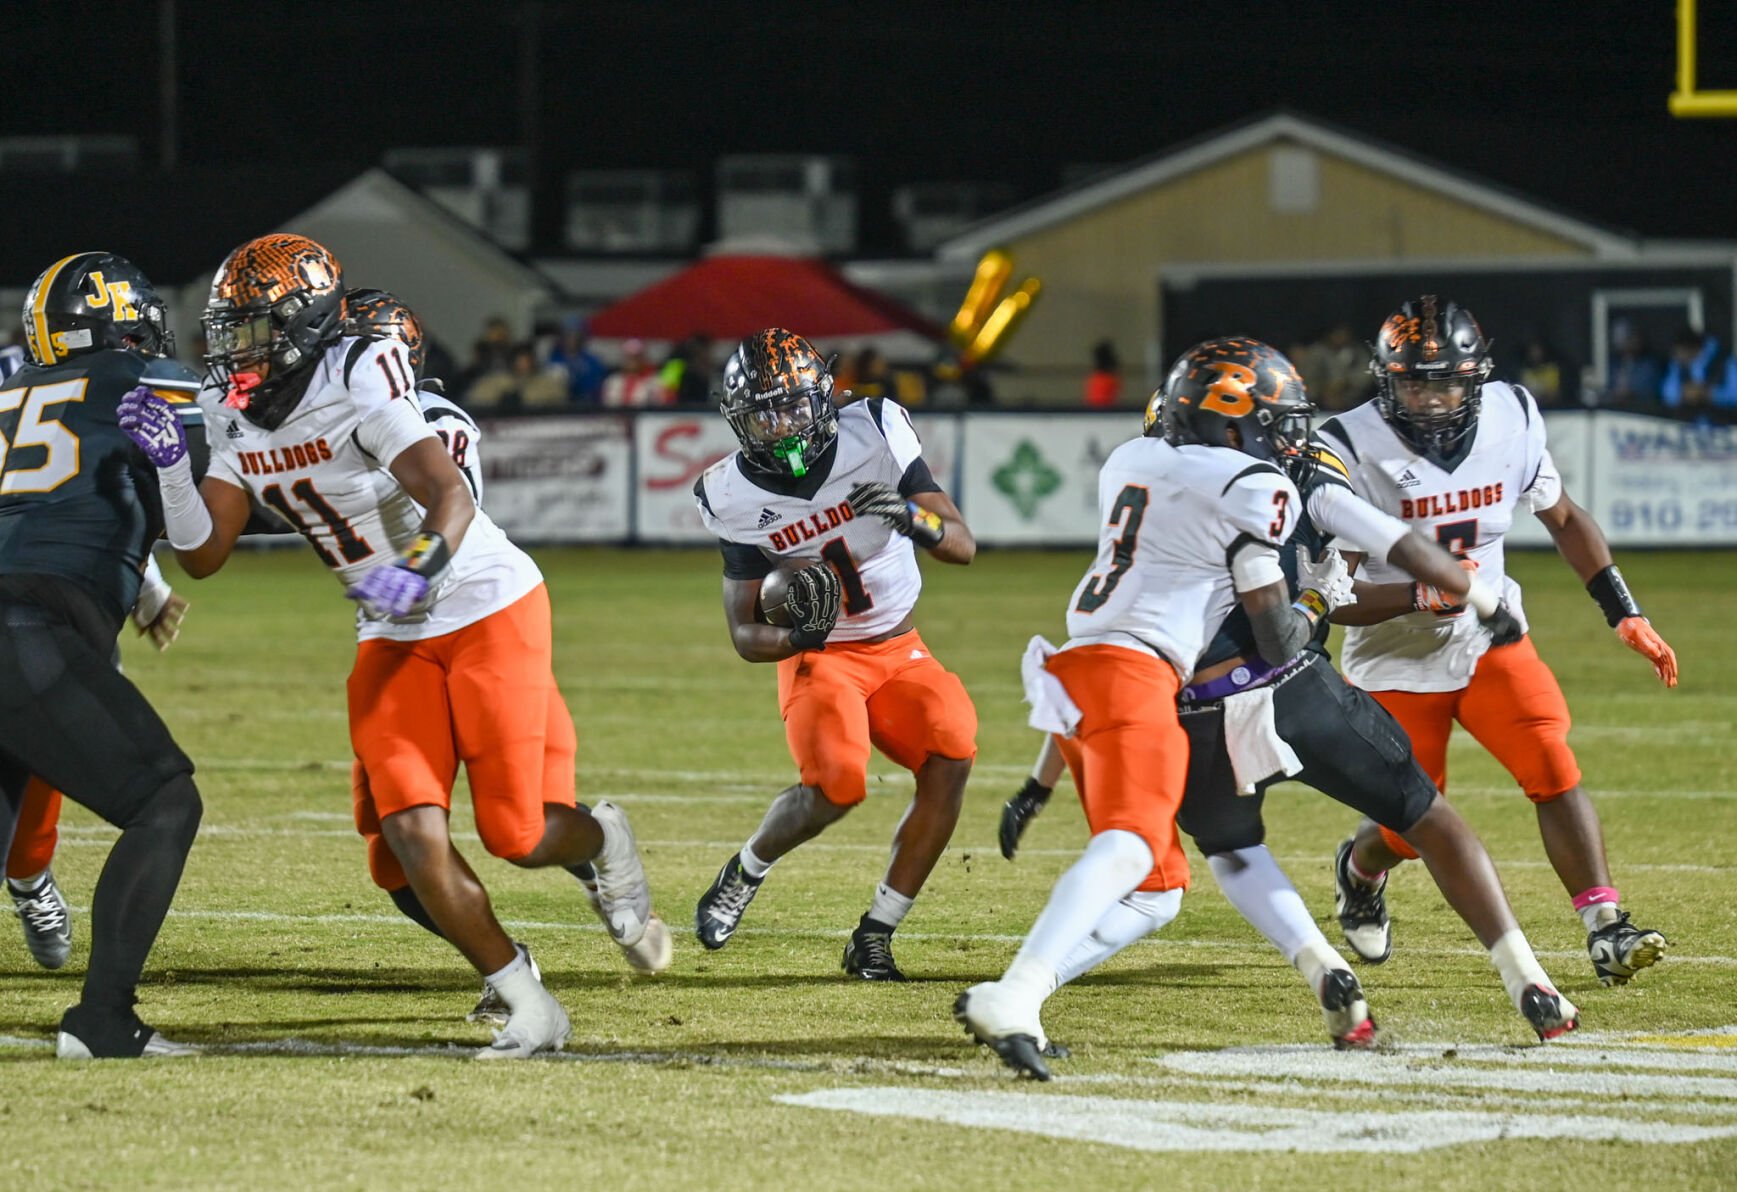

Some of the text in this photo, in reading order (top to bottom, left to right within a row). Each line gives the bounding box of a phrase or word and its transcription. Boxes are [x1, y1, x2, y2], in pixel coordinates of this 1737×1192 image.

[375, 346, 411, 401] 11
[754, 387, 784, 401] Riddell
[1199, 362, 1258, 418] B
[237, 437, 334, 477] BULLDOGS
[262, 477, 375, 568] 11
[767, 500, 855, 553] BULLDO
[1269, 489, 1290, 538] 3
[1400, 481, 1504, 519] BULLDOGS
[1074, 482, 1150, 615] 3
[820, 535, 874, 618] 1
